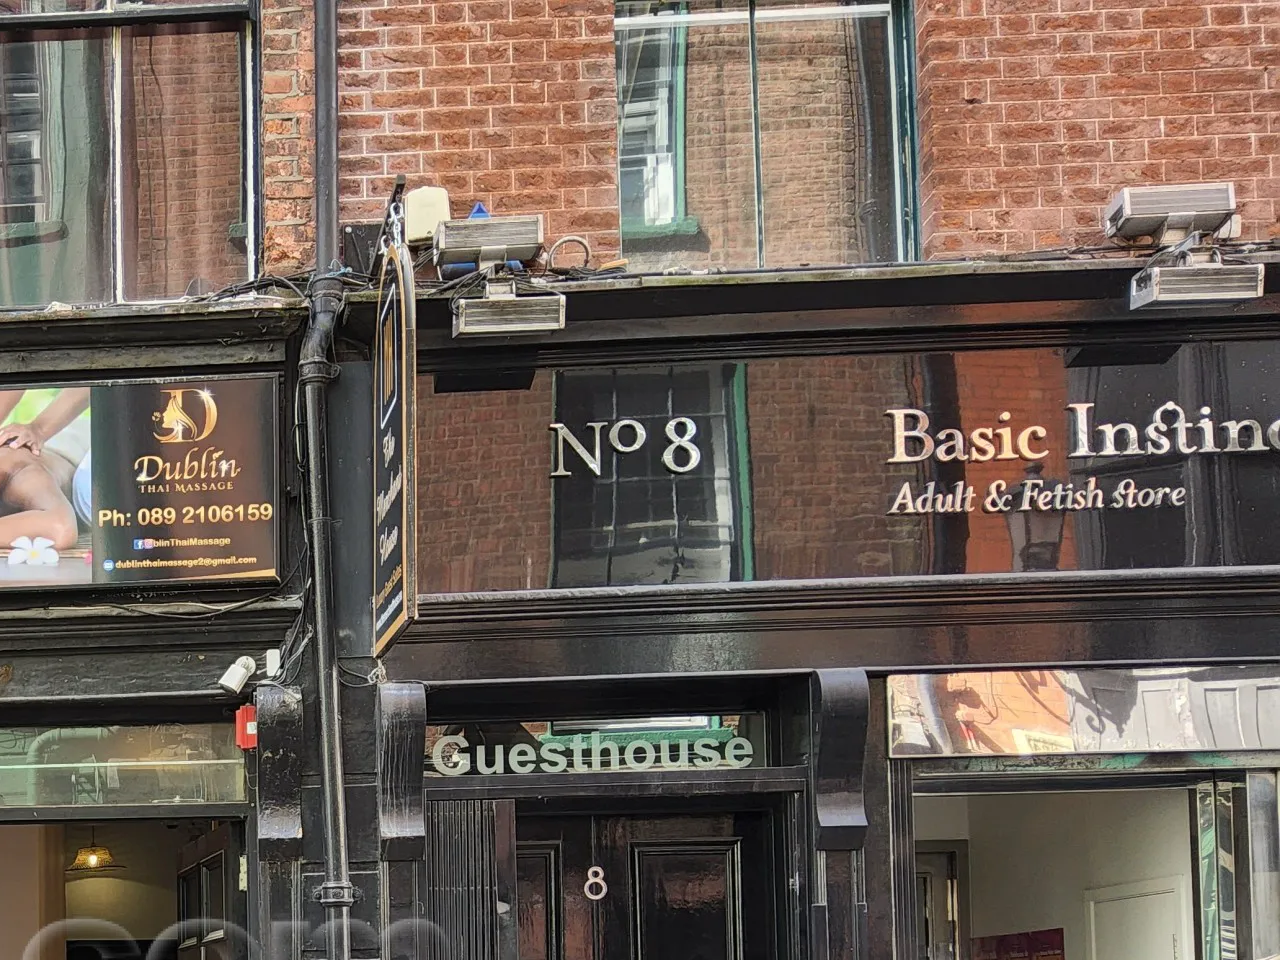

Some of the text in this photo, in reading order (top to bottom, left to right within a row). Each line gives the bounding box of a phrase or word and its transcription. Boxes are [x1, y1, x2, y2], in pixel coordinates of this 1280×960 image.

[661, 417, 701, 474] 8
[887, 407, 1048, 466] Basic
[134, 446, 241, 482] Dublin
[138, 481, 234, 493] THAI MASSAGE
[887, 480, 976, 514] Adult
[985, 480, 1012, 512] &
[1018, 478, 1104, 511] Fetish
[98, 503, 273, 528] Ph: 089 2106159
[153, 537, 231, 548] blinThaiMassage
[115, 556, 257, 569] dublinthaimassage2@gmail.com
[433, 731, 754, 776] Guesthouse
[584, 866, 608, 900] 8
